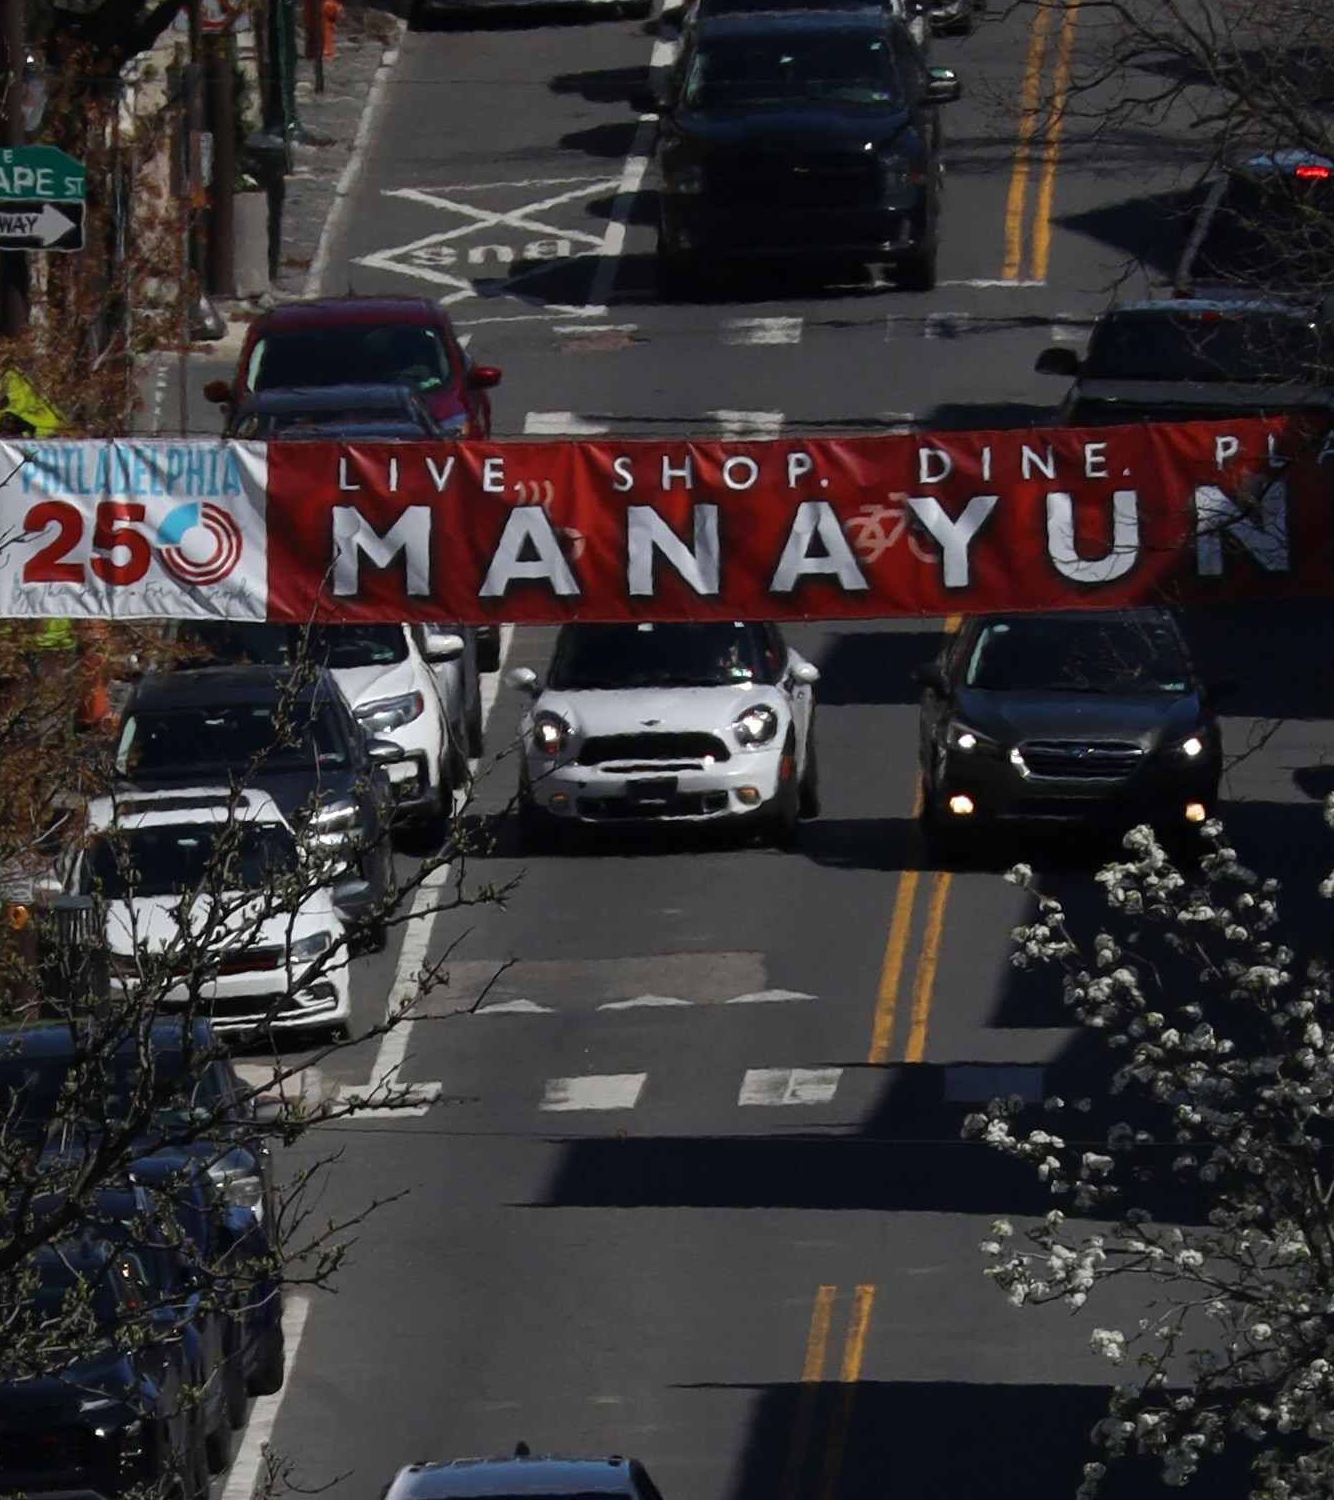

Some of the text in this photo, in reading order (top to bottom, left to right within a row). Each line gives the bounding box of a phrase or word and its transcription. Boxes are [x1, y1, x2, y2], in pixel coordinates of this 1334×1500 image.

[3, 150, 13, 164] E
[64, 176, 85, 196] ST
[22, 447, 242, 497] PHILADELPHIA
[612, 452, 828, 492] SHOP.
[919, 442, 1131, 484] DINE.
[22, 501, 242, 587] 250
